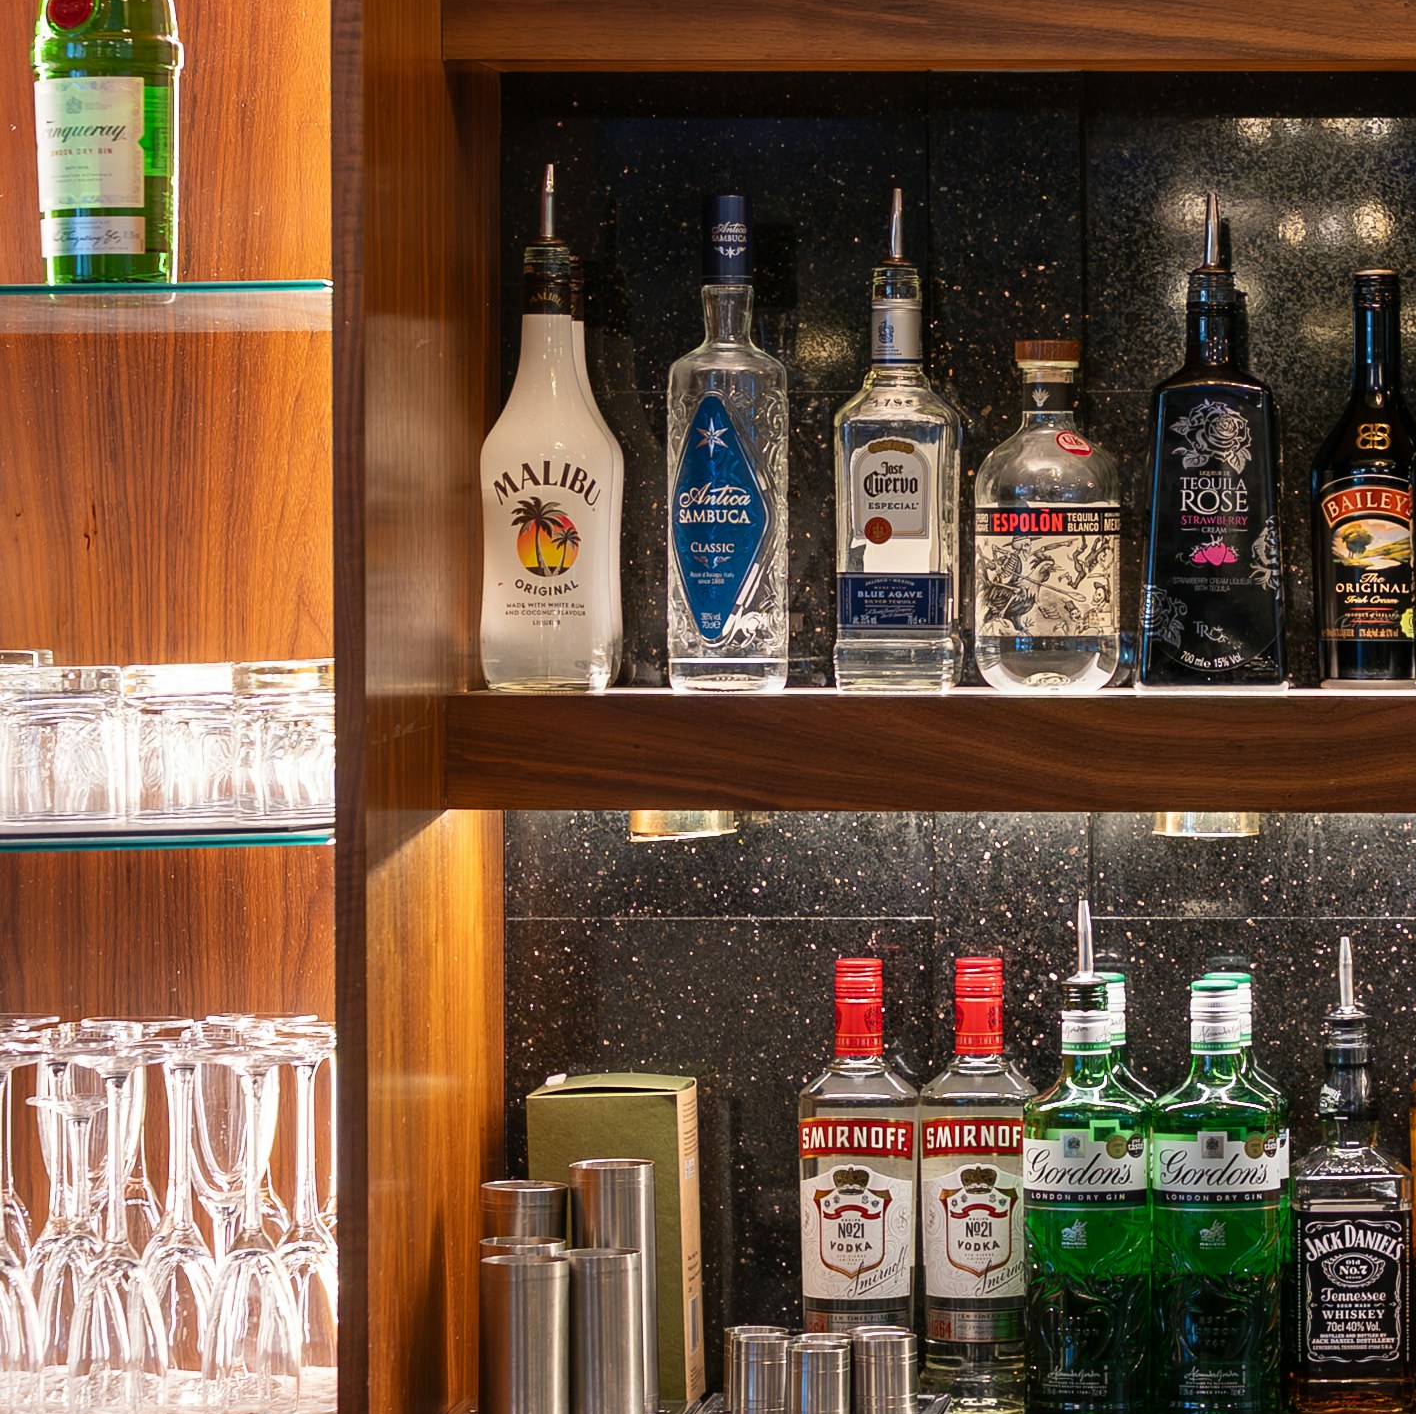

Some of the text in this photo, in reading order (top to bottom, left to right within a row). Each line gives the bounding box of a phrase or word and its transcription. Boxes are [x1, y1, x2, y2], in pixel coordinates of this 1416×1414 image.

[880, 461, 903, 476] Jose
[493, 460, 601, 506] MALIBU
[864, 471, 918, 497] Cuervo
[1180, 477, 1247, 491] TEQUILA
[679, 482, 751, 507] Antica
[868, 502, 918, 510] ESPECIAL
[1180, 489, 1249, 515] ROSE
[679, 509, 751, 524] SAMBUCA
[1067, 513, 1099, 522] TEQUILA
[1181, 515, 1248, 525] STRAWBERRY
[1067, 523, 1099, 532] BLANCO
[690, 542, 735, 553] CLASSIC
[1360, 573, 1385, 583] The
[515, 579, 579, 596] ORIGINAL
[1336, 583, 1409, 594] ORIGINAL
[1344, 595, 1399, 604] Irish Cream
[1181, 651, 1195, 664] 700
[1214, 657, 1229, 667] 15%
[802, 1126, 907, 1151] SMIRNOFF
[926, 1125, 1023, 1149] SMIRNOF
[1027, 1148, 1132, 1186] Gordon's
[1160, 1148, 1268, 1186] Gordon's
[1031, 1192, 1126, 1201] LONDON DRY GIN
[1166, 1193, 1264, 1201] LONDON DRY GIN
[830, 1241, 873, 1253] VODKA
[957, 1240, 1000, 1252] VODKA
[1304, 1224, 1405, 1262] JACK DANIEL'S
[1339, 1266, 1368, 1275] No.7
[1321, 1287, 1386, 1302] Tennessee
[1322, 1309, 1385, 1319] WHISKEY
[930, 1318, 952, 1340] 1864
[1326, 1321, 1381, 1331] 70cl 40% Vol.
